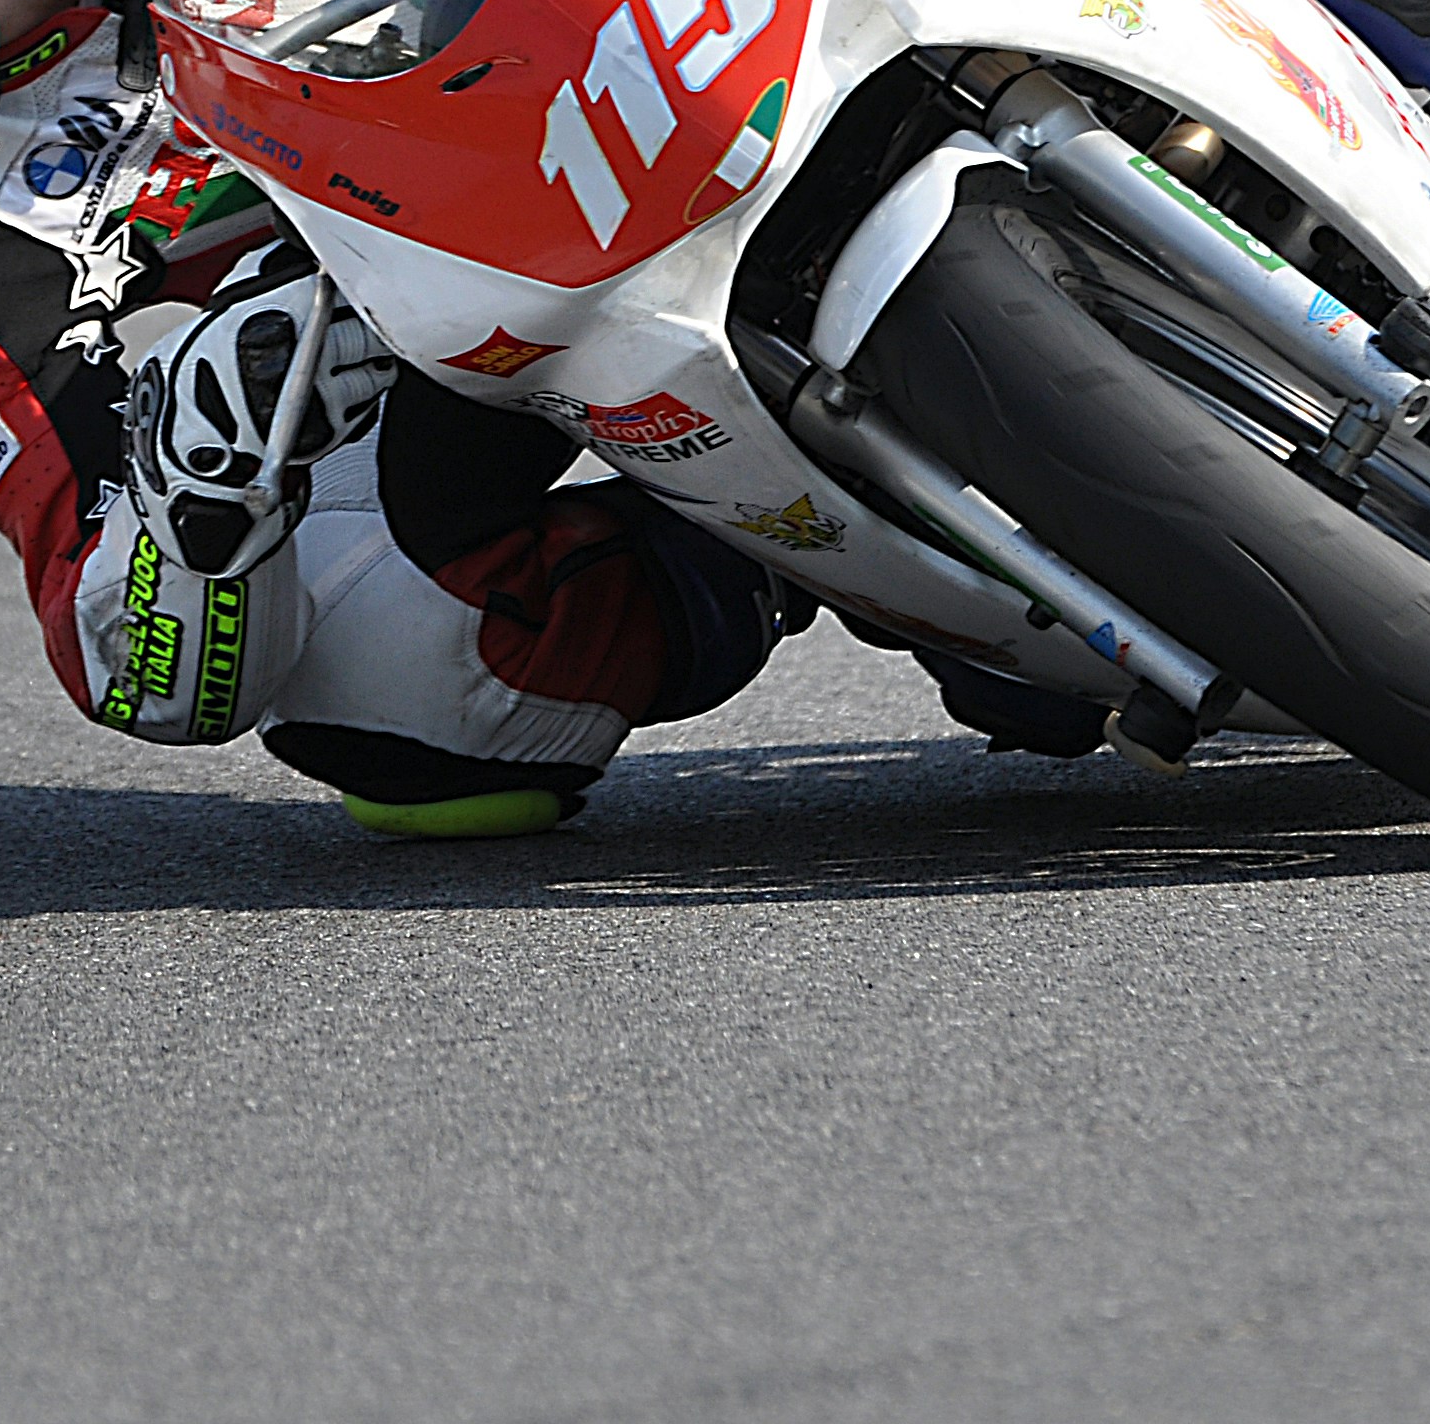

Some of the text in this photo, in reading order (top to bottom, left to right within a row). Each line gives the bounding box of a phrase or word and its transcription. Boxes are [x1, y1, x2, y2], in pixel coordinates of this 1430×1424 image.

[226, 114, 303, 171] DUCATO
[81, 151, 121, 229] CENTAURO
[328, 173, 401, 216] Puig
[472, 345, 515, 366] SAN
[483, 346, 543, 374] CARLO
[589, 408, 700, 443] Trophy
[127, 535, 159, 618] FUOC
[145, 616, 178, 695] ITALIA
